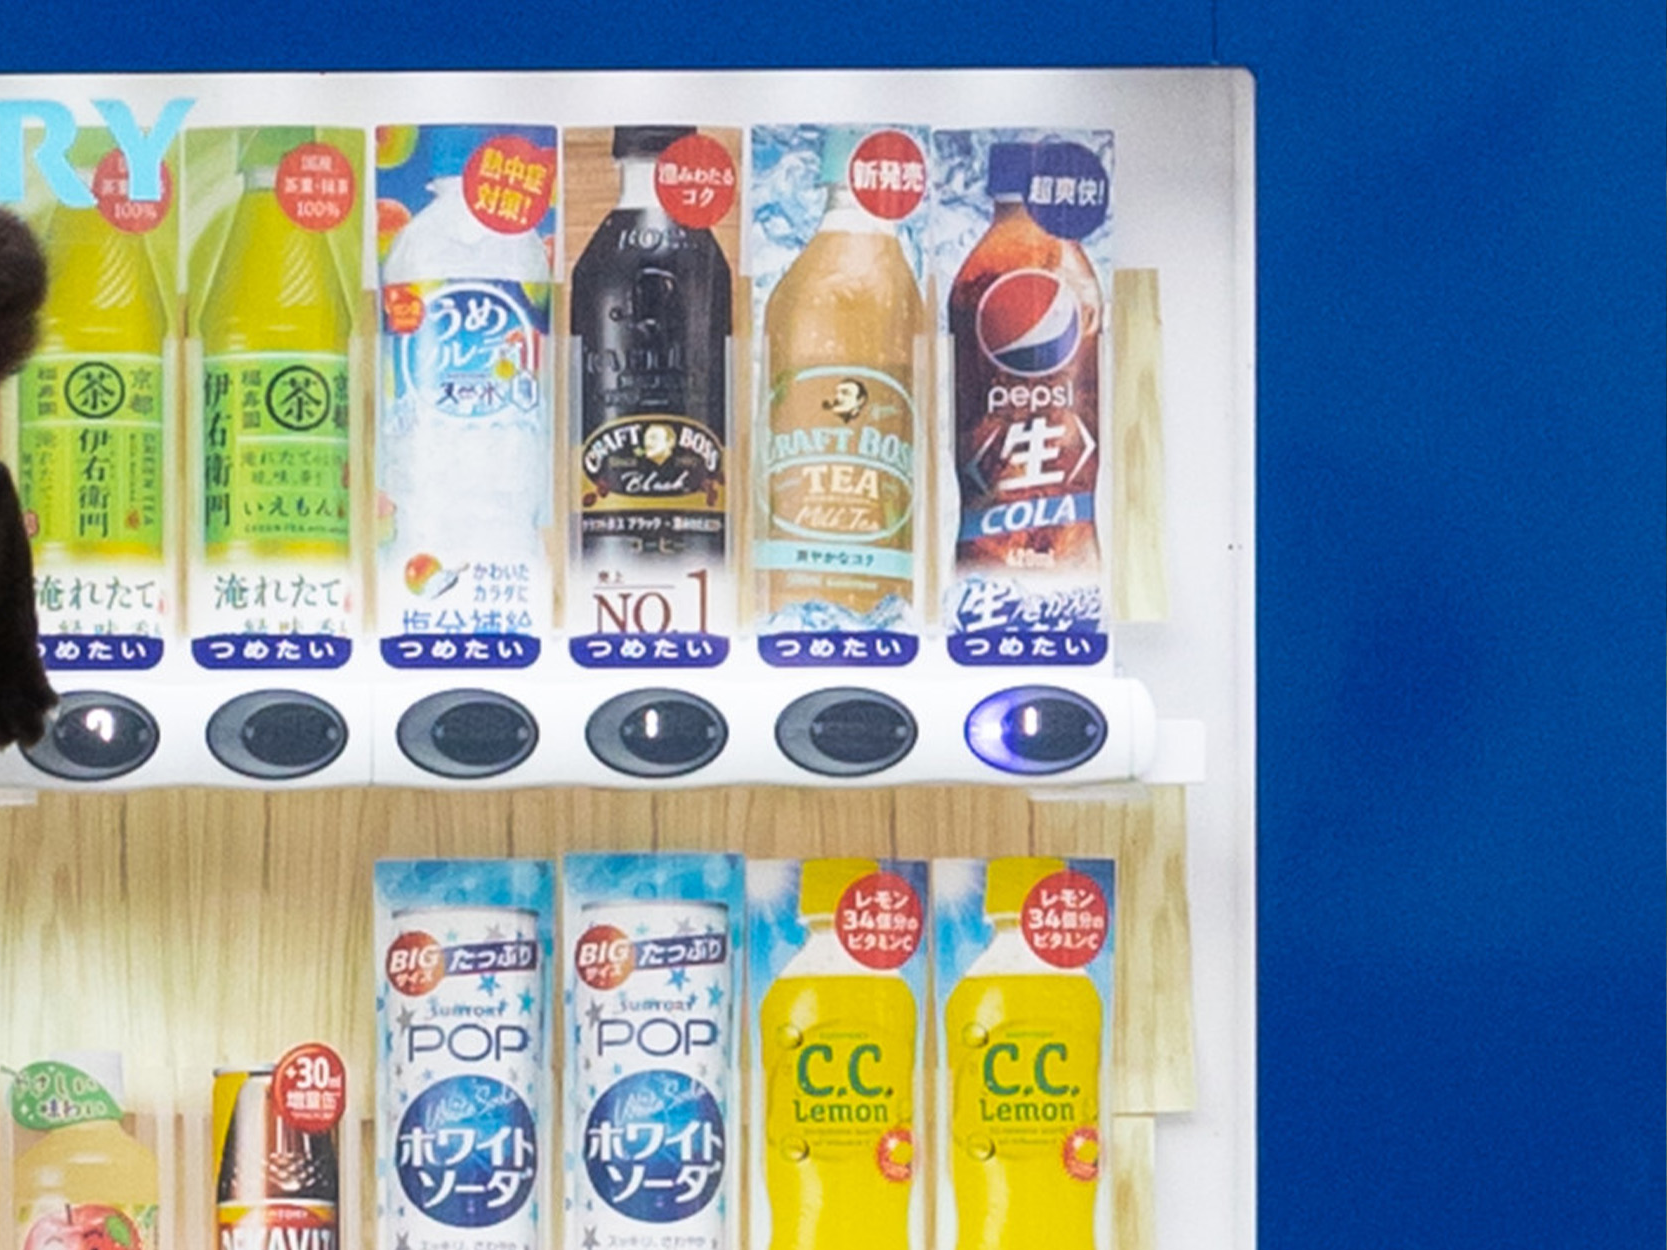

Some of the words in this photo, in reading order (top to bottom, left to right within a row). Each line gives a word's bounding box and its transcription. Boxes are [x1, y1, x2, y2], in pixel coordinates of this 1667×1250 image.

[851, 158, 926, 193] 新発売
[294, 201, 342, 221] 100%
[682, 189, 715, 207] コク
[430, 297, 509, 341] うめ
[987, 382, 1073, 414] pepsi
[584, 423, 643, 474] CRAFT
[678, 426, 720, 473] BOSS
[78, 428, 110, 538] 伊右衛門
[802, 464, 880, 499] TEA
[244, 497, 334, 518] いえもん
[980, 492, 1076, 535] COLA
[213, 573, 341, 611] 淹れたて
[35, 640, 147, 661] めたい
[210, 640, 334, 661] つめたい
[398, 639, 524, 659] つめたい
[586, 638, 712, 659] つめたい
[775, 637, 901, 658] つめたい
[965, 636, 1091, 656] つめたい
[855, 890, 908, 909] レモン
[1041, 889, 1094, 908] レモン
[578, 939, 631, 966] BIG
[638, 938, 723, 966] たっぷり
[847, 933, 914, 952] ビタミンC
[1033, 932, 1100, 951] ビタミンC
[389, 944, 439, 974] BIG
[447, 944, 533, 972] たっぷり
[408, 1022, 529, 1062] POP
[597, 1017, 719, 1056] POP
[797, 1043, 894, 1099] C.C.
[983, 1042, 1081, 1097] C.C.
[793, 1099, 890, 1124] Lemon
[980, 1098, 1076, 1122] Lemon
[398, 1126, 534, 1167] ホワイト
[587, 1120, 724, 1162] ホワイト
[420, 1164, 534, 1208] ソーダ
[607, 1159, 722, 1203] ソーダ
